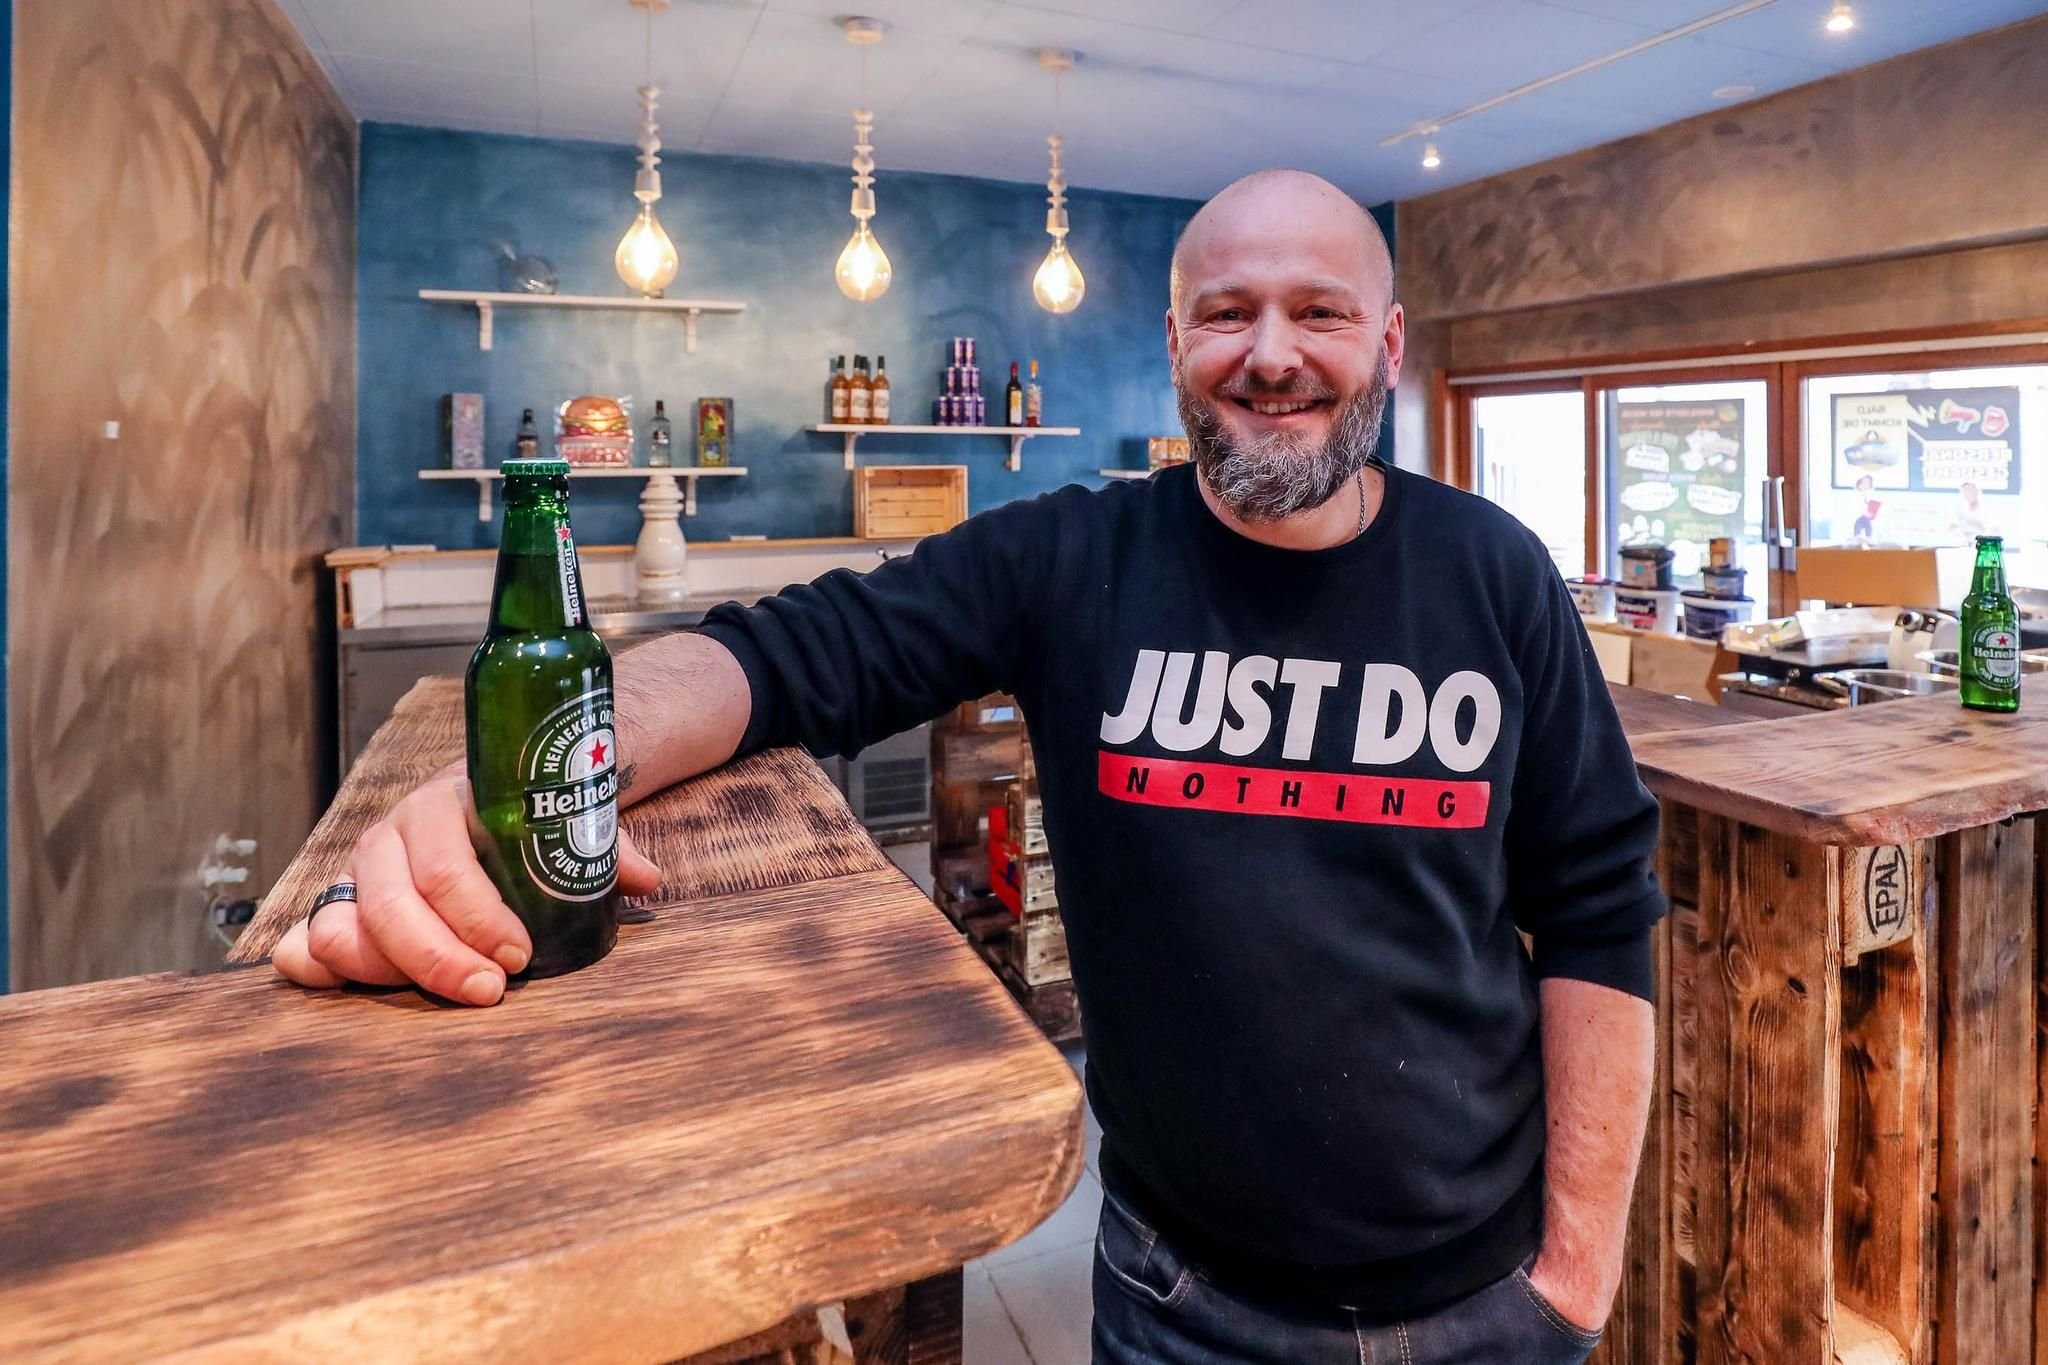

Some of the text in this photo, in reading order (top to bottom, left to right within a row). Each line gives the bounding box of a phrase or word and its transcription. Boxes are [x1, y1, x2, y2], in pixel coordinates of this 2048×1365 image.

[1099, 649, 1502, 773] JUST DO
[543, 713, 597, 773] HEINEKEN
[1125, 766, 1457, 819] NOTHING
[549, 847, 582, 878] PURE
[585, 854, 611, 879] MALT
[1875, 850, 1899, 928] EPAL
